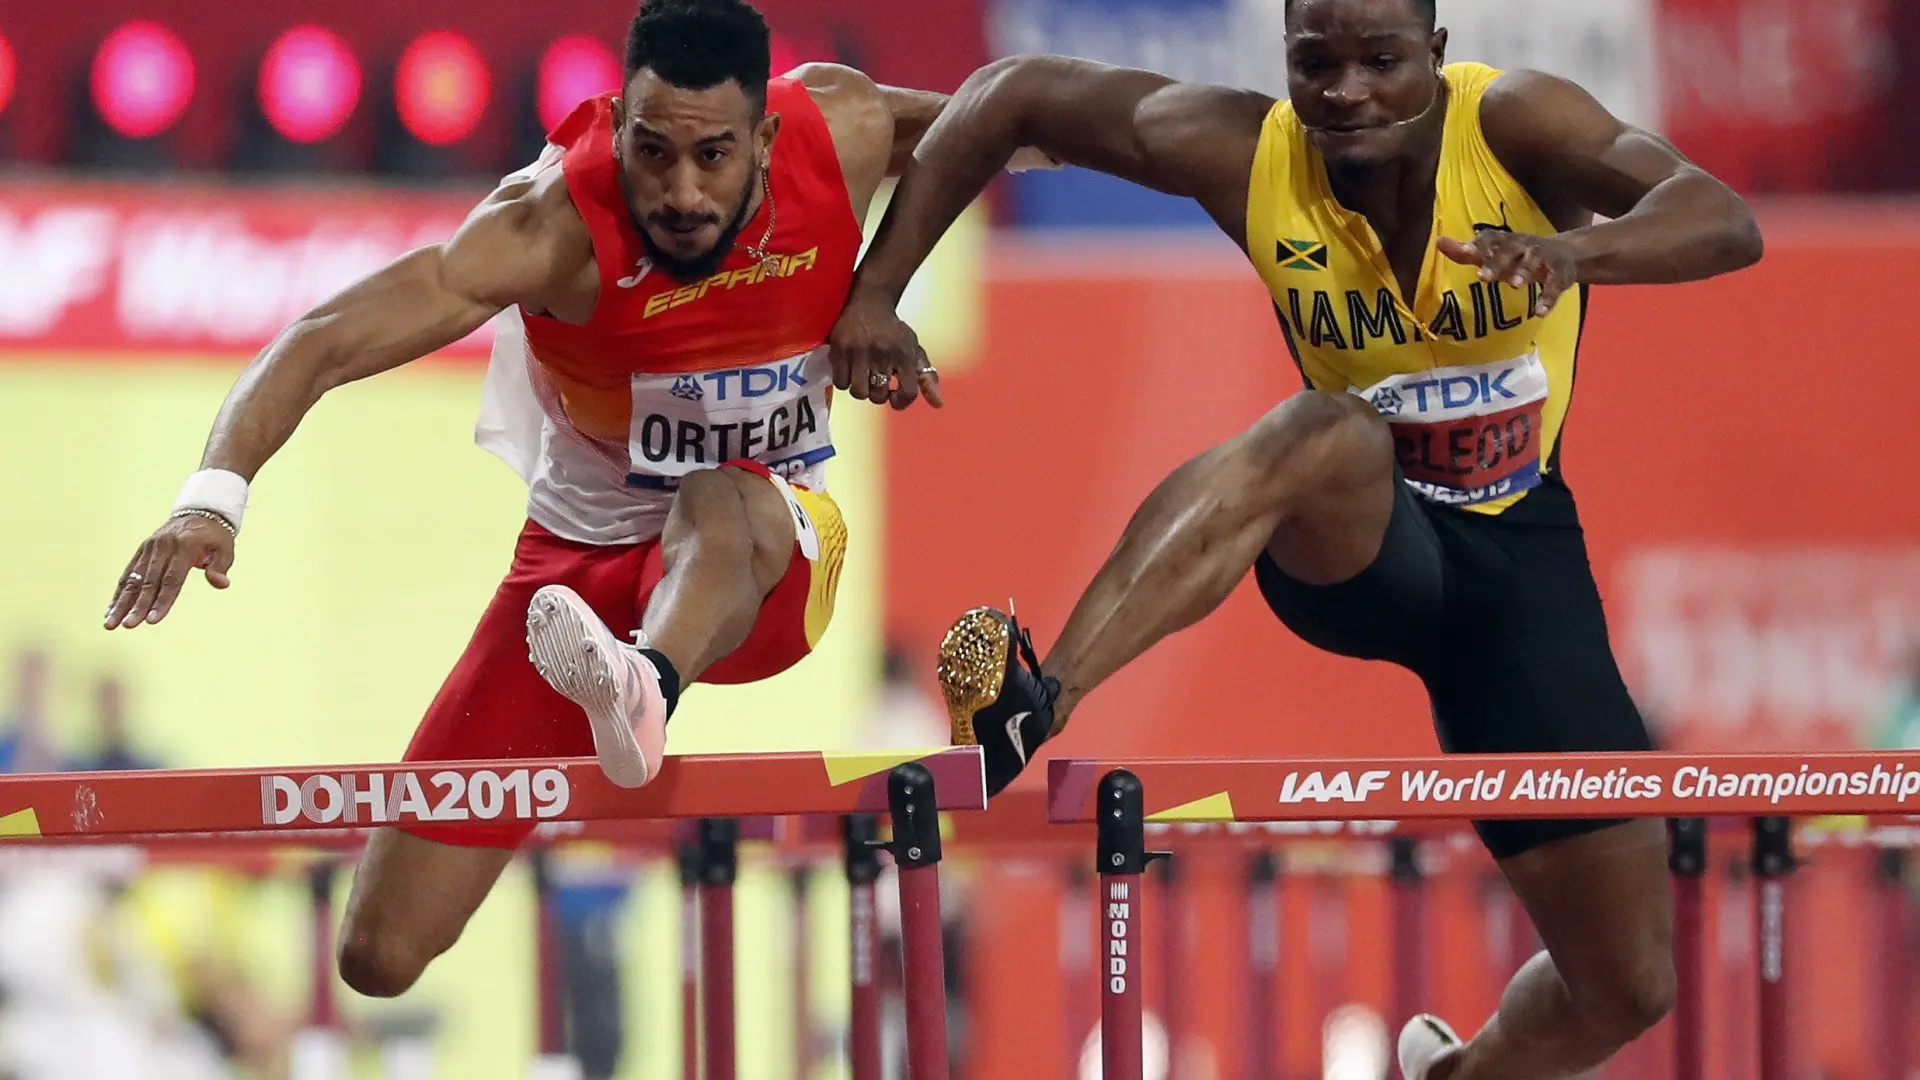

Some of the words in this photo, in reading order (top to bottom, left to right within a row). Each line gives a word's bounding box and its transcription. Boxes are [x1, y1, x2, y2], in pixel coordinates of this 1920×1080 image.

[703, 356, 809, 401] TDK
[1402, 368, 1519, 413] TDK
[641, 396, 816, 464] ORTEGA
[260, 768, 571, 825] DOHA2019
[1278, 770, 1391, 803] IAAF
[1401, 769, 1506, 802] World
[1508, 767, 1662, 800] Athletics
[1108, 902, 1130, 995] MONDO
